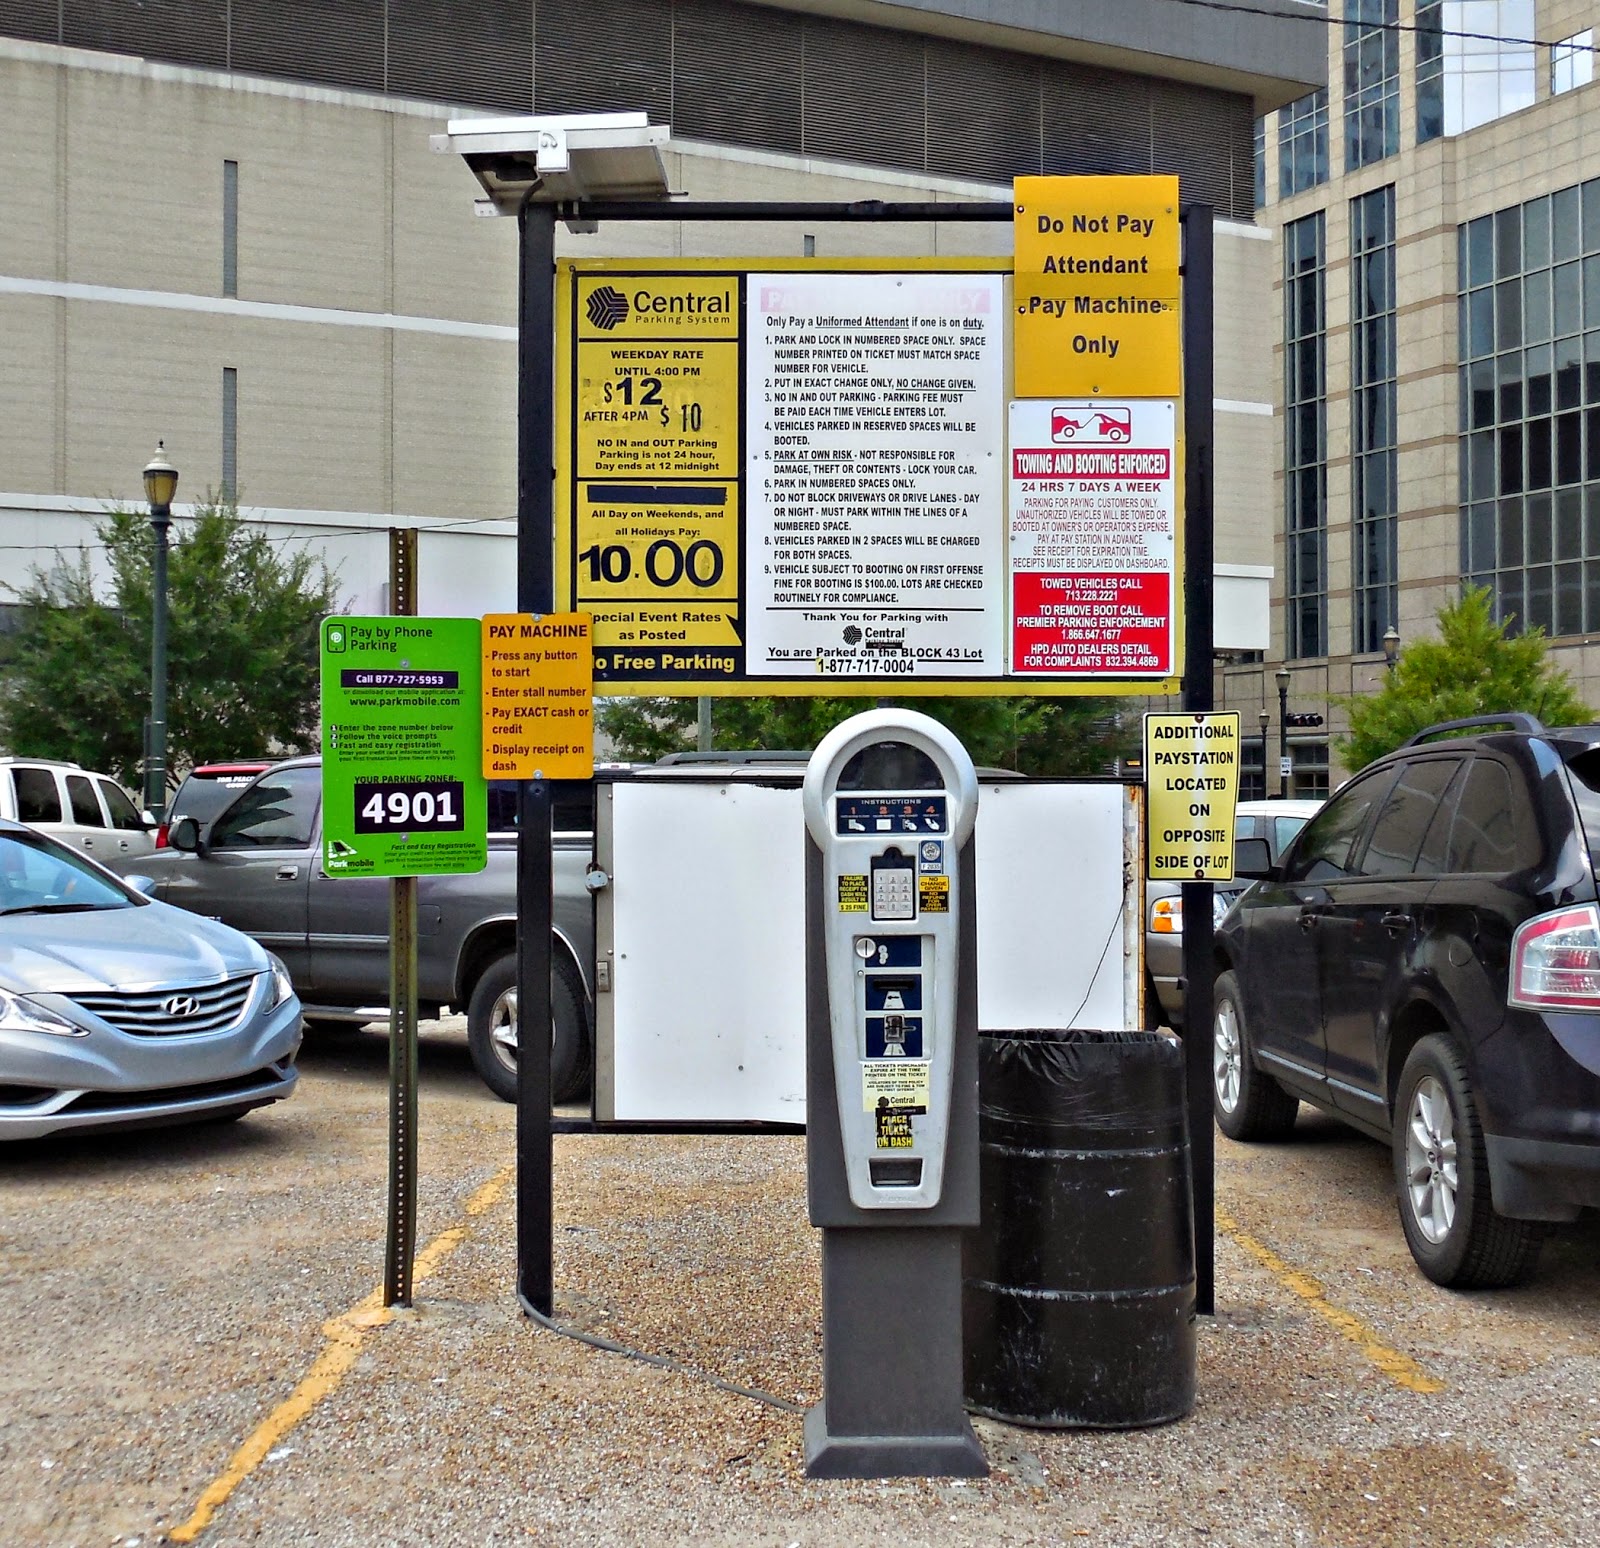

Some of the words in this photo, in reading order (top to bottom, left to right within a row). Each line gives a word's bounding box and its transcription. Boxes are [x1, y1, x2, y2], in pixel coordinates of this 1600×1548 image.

[1038, 216, 1064, 233] Do
[1072, 215, 1108, 233] Not
[1117, 214, 1154, 238] Pay
[1042, 255, 1148, 274] Attendant
[634, 291, 730, 313] Central
[1029, 296, 1066, 318] Pay
[1074, 296, 1162, 314] Machine
[635, 315, 682, 325] Parking
[687, 315, 730, 325] System
[766, 316, 786, 329] Only
[789, 316, 806, 329] Pay
[808, 318, 813, 326] a
[816, 316, 862, 326] Uniformed
[864, 316, 909, 326] Attendant
[912, 316, 918, 326] if
[939, 316, 947, 326] is
[962, 317, 984, 329] duty.
[765, 335, 772, 344] 1.
[774, 335, 796, 344] PARK
[798, 335, 816, 344] AND
[818, 335, 841, 344] LOCK
[843, 335, 852, 344] IN
[854, 335, 901, 345] NUMBERED
[903, 335, 929, 345] SPACE
[932, 336, 955, 345] ONLY.
[960, 336, 986, 346] SPACE
[1072, 335, 1119, 358] Only
[611, 350, 669, 359] WEEKDAY
[673, 350, 704, 359] RATE
[614, 367, 651, 376] UNTIL
[654, 367, 679, 376] 4:00
[683, 367, 700, 376] PM
[584, 411, 618, 422] AFTER
[622, 410, 648, 421] 4PM
[597, 439, 613, 447] NO
[616, 439, 627, 447] IN
[630, 439, 649, 447] and
[652, 439, 675, 447] OUT
[678, 439, 718, 449] Parking
[1016, 454, 1052, 474] TOWING
[1054, 454, 1074, 474] AND
[1075, 454, 1116, 474] BOOTING
[1118, 454, 1166, 474] ENFORCED
[1022, 482, 1036, 492] 24
[1040, 482, 1064, 492] HRS
[1068, 482, 1075, 492] 7
[1080, 482, 1110, 492] DAYS
[1114, 482, 1122, 492] A
[1126, 482, 1161, 492] WEEK
[592, 510, 605, 518] All
[608, 510, 628, 520] Day
[646, 510, 702, 519] Weekends,
[705, 510, 724, 518] and
[631, 528, 676, 538] Holidays
[678, 528, 700, 538] Pay:
[579, 539, 724, 588] 10.00
[1040, 578, 1072, 589] TOWED
[1074, 578, 1118, 589] VEHICLES
[1119, 578, 1142, 589] CALL
[1065, 590, 1118, 601] 713.228.2221
[1039, 605, 1052, 616] TO
[1053, 605, 1091, 616] REMOVE
[1093, 605, 1118, 616] BOOT
[1120, 605, 1143, 616] CALL
[588, 612, 634, 623] pecial
[639, 612, 677, 622] Event
[682, 612, 721, 622] Rates
[802, 612, 836, 621] Thank
[840, 613, 859, 621] You
[862, 613, 877, 621] for
[881, 613, 922, 624] Parking
[924, 614, 948, 622] with
[1017, 617, 1056, 628] PREMIER
[1058, 617, 1097, 628] PARKING
[1099, 617, 1166, 628] ENFORCEMENT
[350, 626, 372, 638] Pay
[376, 626, 390, 638] by
[395, 626, 433, 638] Phone
[490, 626, 516, 638] PAY
[520, 625, 587, 638] MACHINE
[619, 632, 634, 640] as
[640, 630, 686, 640] Posted
[865, 627, 905, 638] Central
[1062, 629, 1121, 640] 1.866.647.1677
[351, 639, 397, 653] Parking
[492, 650, 520, 660] Press
[523, 652, 542, 663] any
[544, 650, 578, 660] button
[767, 647, 790, 658] You
[793, 647, 813, 658] are
[816, 647, 857, 658] Parked
[860, 647, 874, 658] on
[878, 647, 897, 658] the
[901, 647, 942, 658] BLOCK
[946, 647, 961, 658] 43
[964, 647, 983, 658] Lot
[592, 655, 607, 669] o
[614, 654, 656, 669] Free
[662, 654, 734, 673] Parking
[818, 658, 914, 673] 1-877-717-0004
[1024, 656, 1043, 666] FOR
[1044, 656, 1102, 666] COMPLAINTS
[492, 668, 502, 677] to
[505, 667, 530, 677] start
[356, 674, 373, 683] Call
[375, 675, 444, 684] 877-727-5953
[492, 687, 520, 697] Enter
[523, 686, 545, 697] stall
[548, 686, 586, 697] number
[350, 697, 460, 707] www.parkmobile.com
[492, 707, 511, 720] Pay
[514, 707, 549, 717] EXACT
[551, 707, 575, 717] cash
[578, 709, 589, 717] or
[492, 724, 522, 734] credit
[1154, 725, 1234, 739] ADDITIONAL
[492, 744, 530, 756] Display
[533, 744, 569, 756] receipt
[572, 746, 584, 754] on
[1155, 751, 1233, 765] PAYSTATION
[492, 760, 517, 771] dash
[1166, 778, 1226, 790] LOCATED
[362, 792, 457, 824] 4901
[1189, 804, 1210, 816] ON
[1163, 830, 1225, 842] OPPOSITE
[1154, 856, 1188, 868] SIDE
[1193, 856, 1211, 868] OF
[1213, 856, 1229, 868] LOT
[890, 1096, 916, 1104] Central
